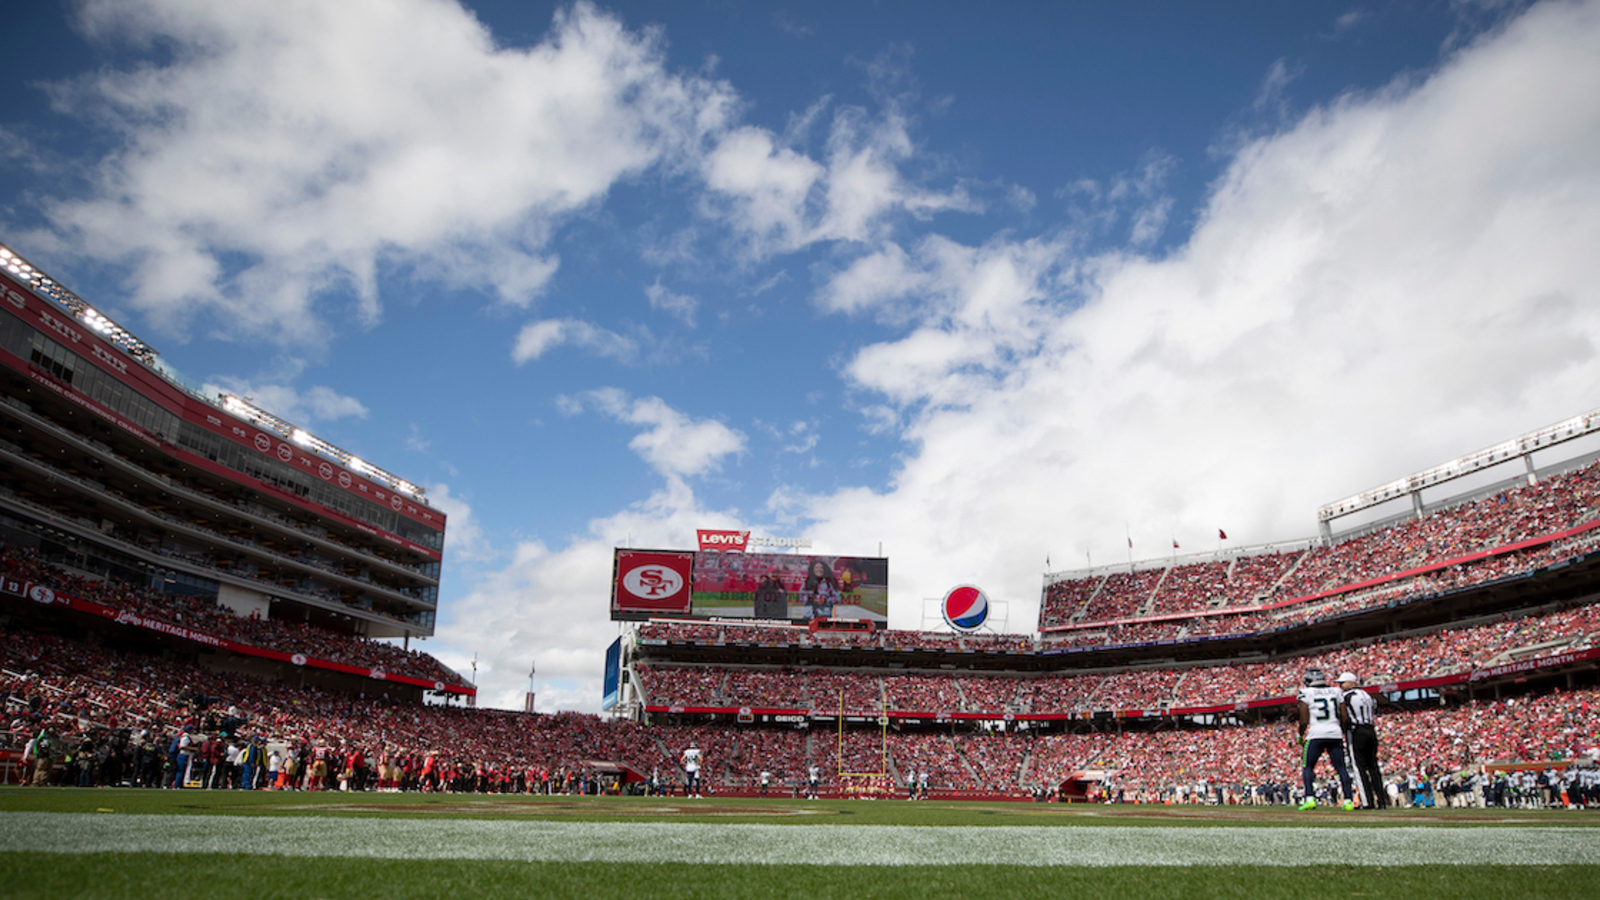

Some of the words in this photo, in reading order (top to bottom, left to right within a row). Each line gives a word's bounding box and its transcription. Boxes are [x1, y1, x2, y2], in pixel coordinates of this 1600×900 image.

[64, 390, 117, 423] CONFERENCE
[753, 536, 813, 548] STADIUM
[114, 609, 142, 626] Latino
[143, 617, 188, 638] HERITAGE
[189, 630, 220, 647] MONTH
[1491, 661, 1536, 676] HERITAGE
[1537, 653, 1575, 667] MONTH
[774, 715, 805, 723] GEICO
[825, 709, 861, 717] HERTAGE
[1313, 697, 1340, 721] 31
